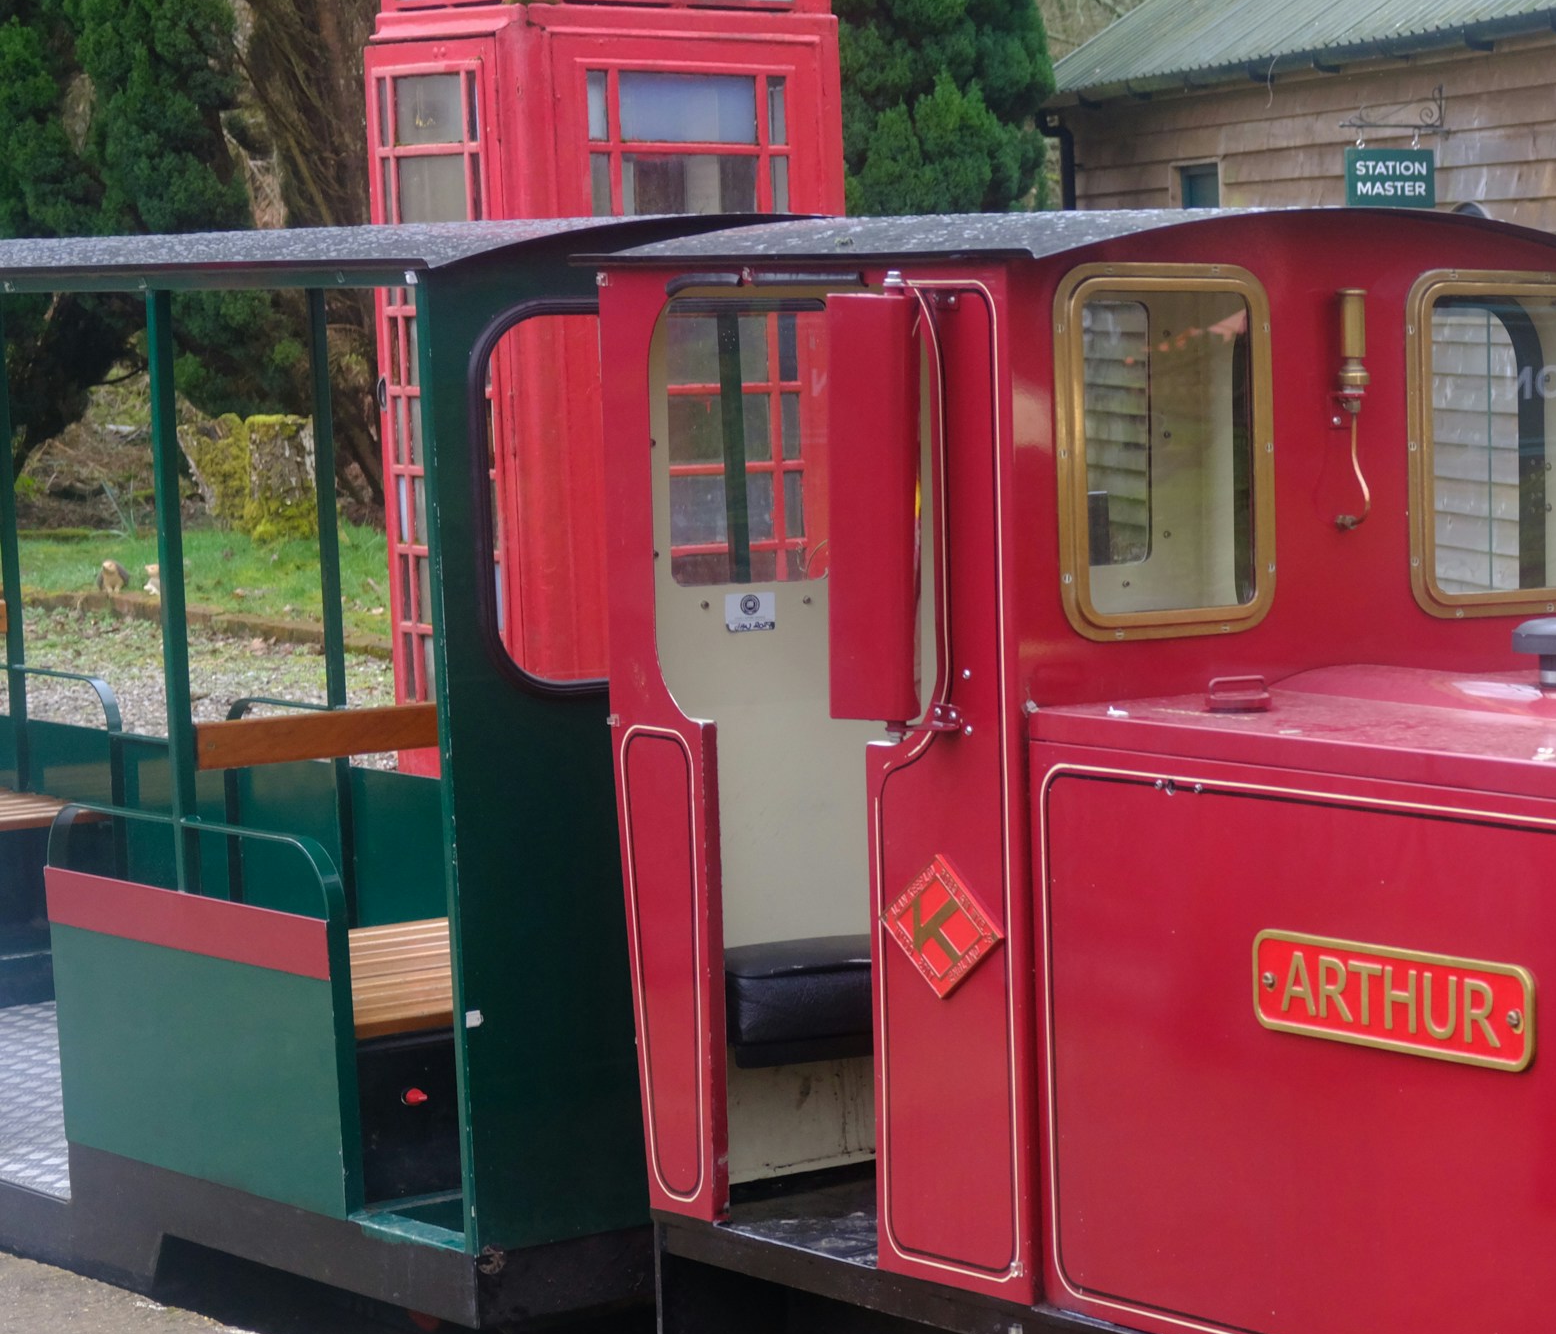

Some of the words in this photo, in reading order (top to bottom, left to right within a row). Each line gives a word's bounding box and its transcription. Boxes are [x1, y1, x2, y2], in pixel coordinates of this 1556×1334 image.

[1355, 160, 1427, 176] STATION
[1356, 180, 1426, 196] MASTER
[1281, 950, 1501, 1049] ARTHUR
